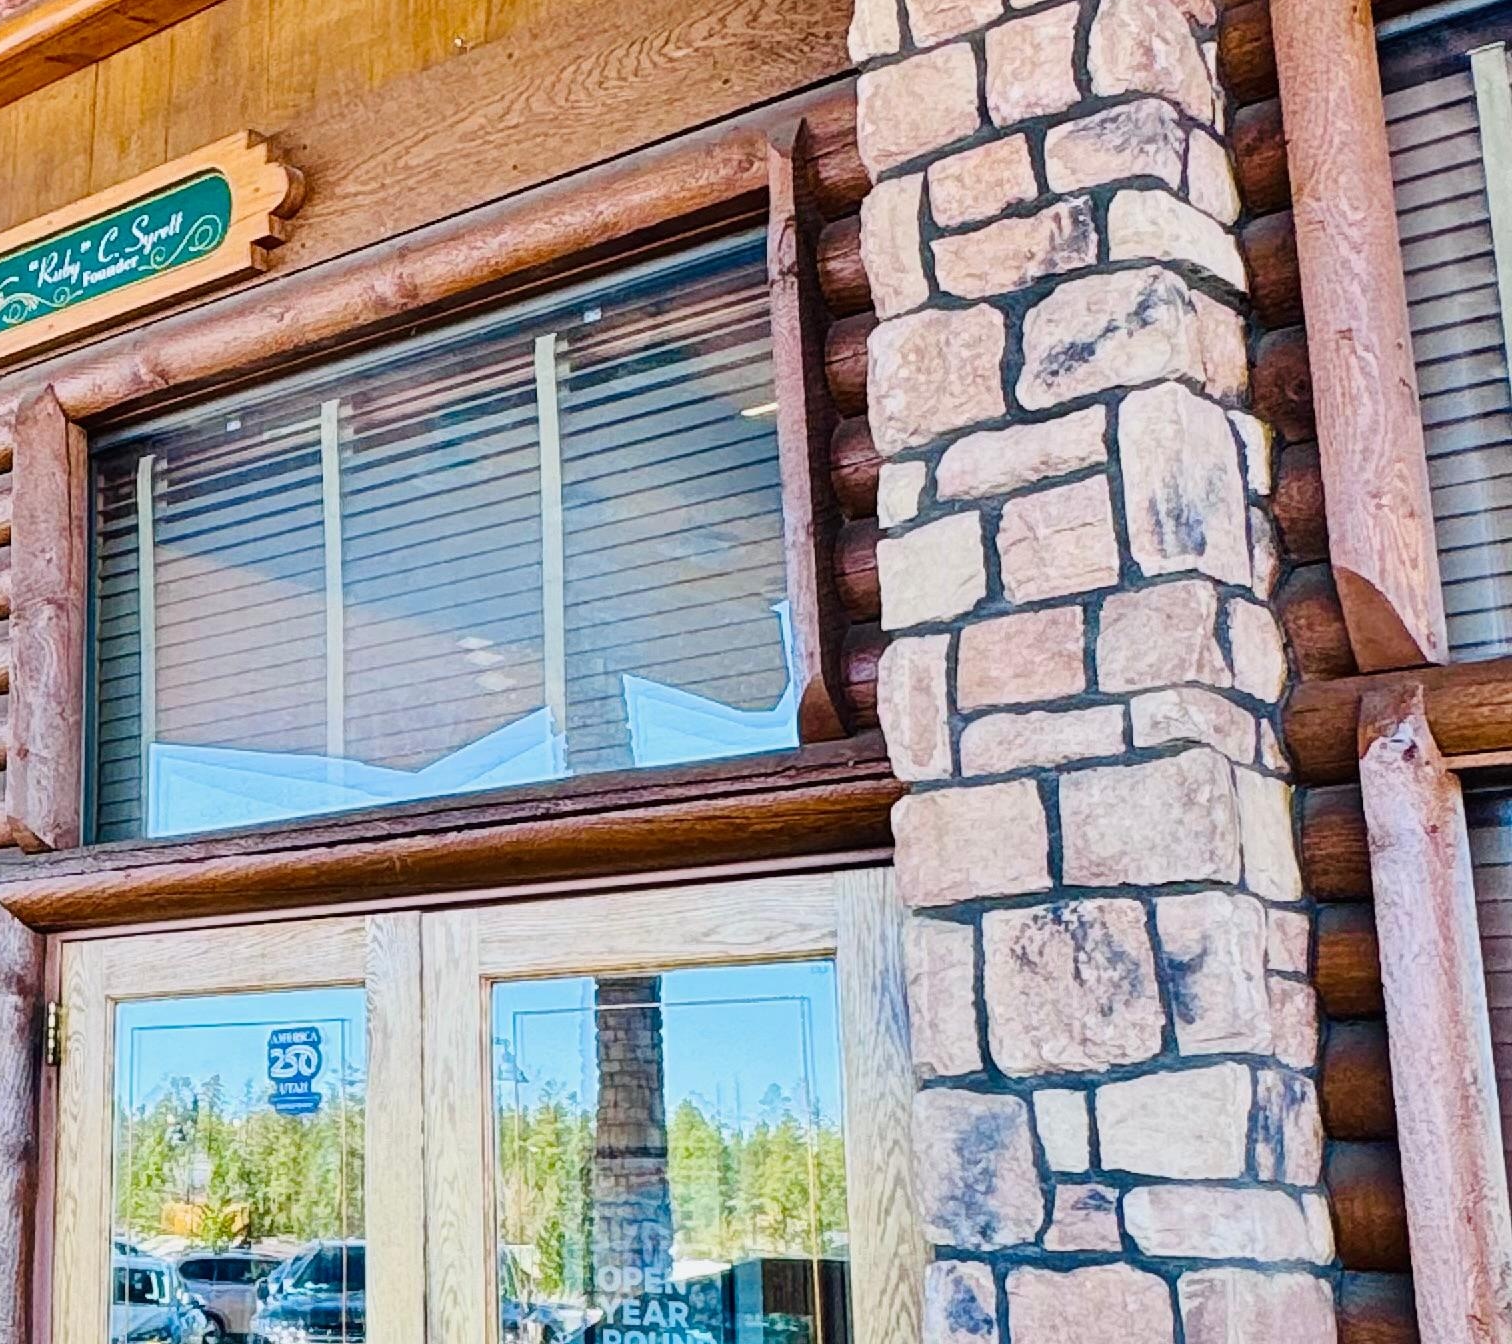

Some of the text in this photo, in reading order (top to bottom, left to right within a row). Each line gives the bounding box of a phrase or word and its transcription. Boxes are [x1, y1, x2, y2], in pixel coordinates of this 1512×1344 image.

[97, 226, 120, 263] C.
[82, 255, 140, 288] Founder
[270, 1044, 318, 1078] 250
[596, 1264, 687, 1296] OPEN
[599, 1295, 690, 1329] YEAR
